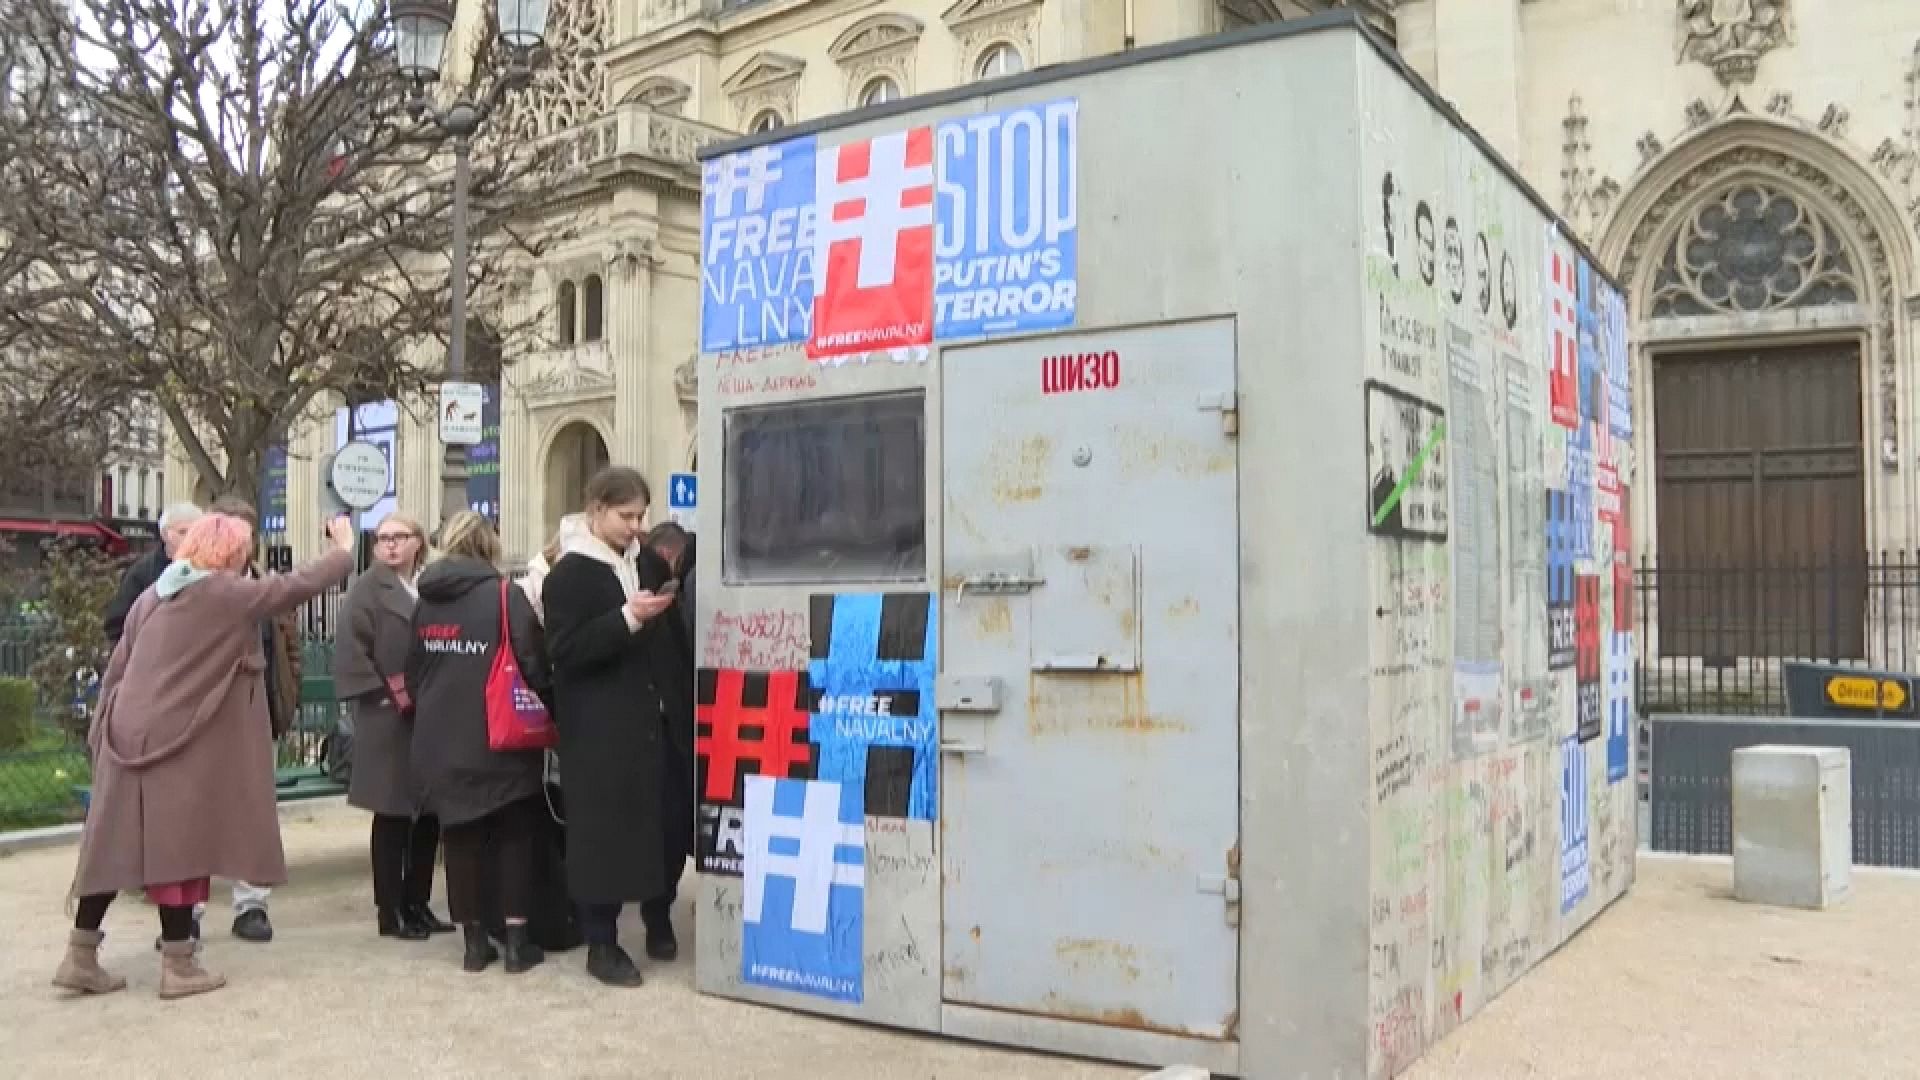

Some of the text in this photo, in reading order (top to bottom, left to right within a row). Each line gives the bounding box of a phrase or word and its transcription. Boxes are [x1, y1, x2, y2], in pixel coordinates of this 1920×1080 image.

[937, 101, 1077, 257] STOP
[707, 203, 816, 265] FREE
[936, 248, 1062, 289] PUTIN'S
[935, 280, 1077, 323] TERROR
[816, 322, 925, 349] #FREENAVALNY
[1042, 350, 1119, 395] ШИЗО
[818, 695, 893, 717] #FREE
[836, 719, 933, 741] NAVALNY
[751, 964, 855, 993] #FREENAVALNY
